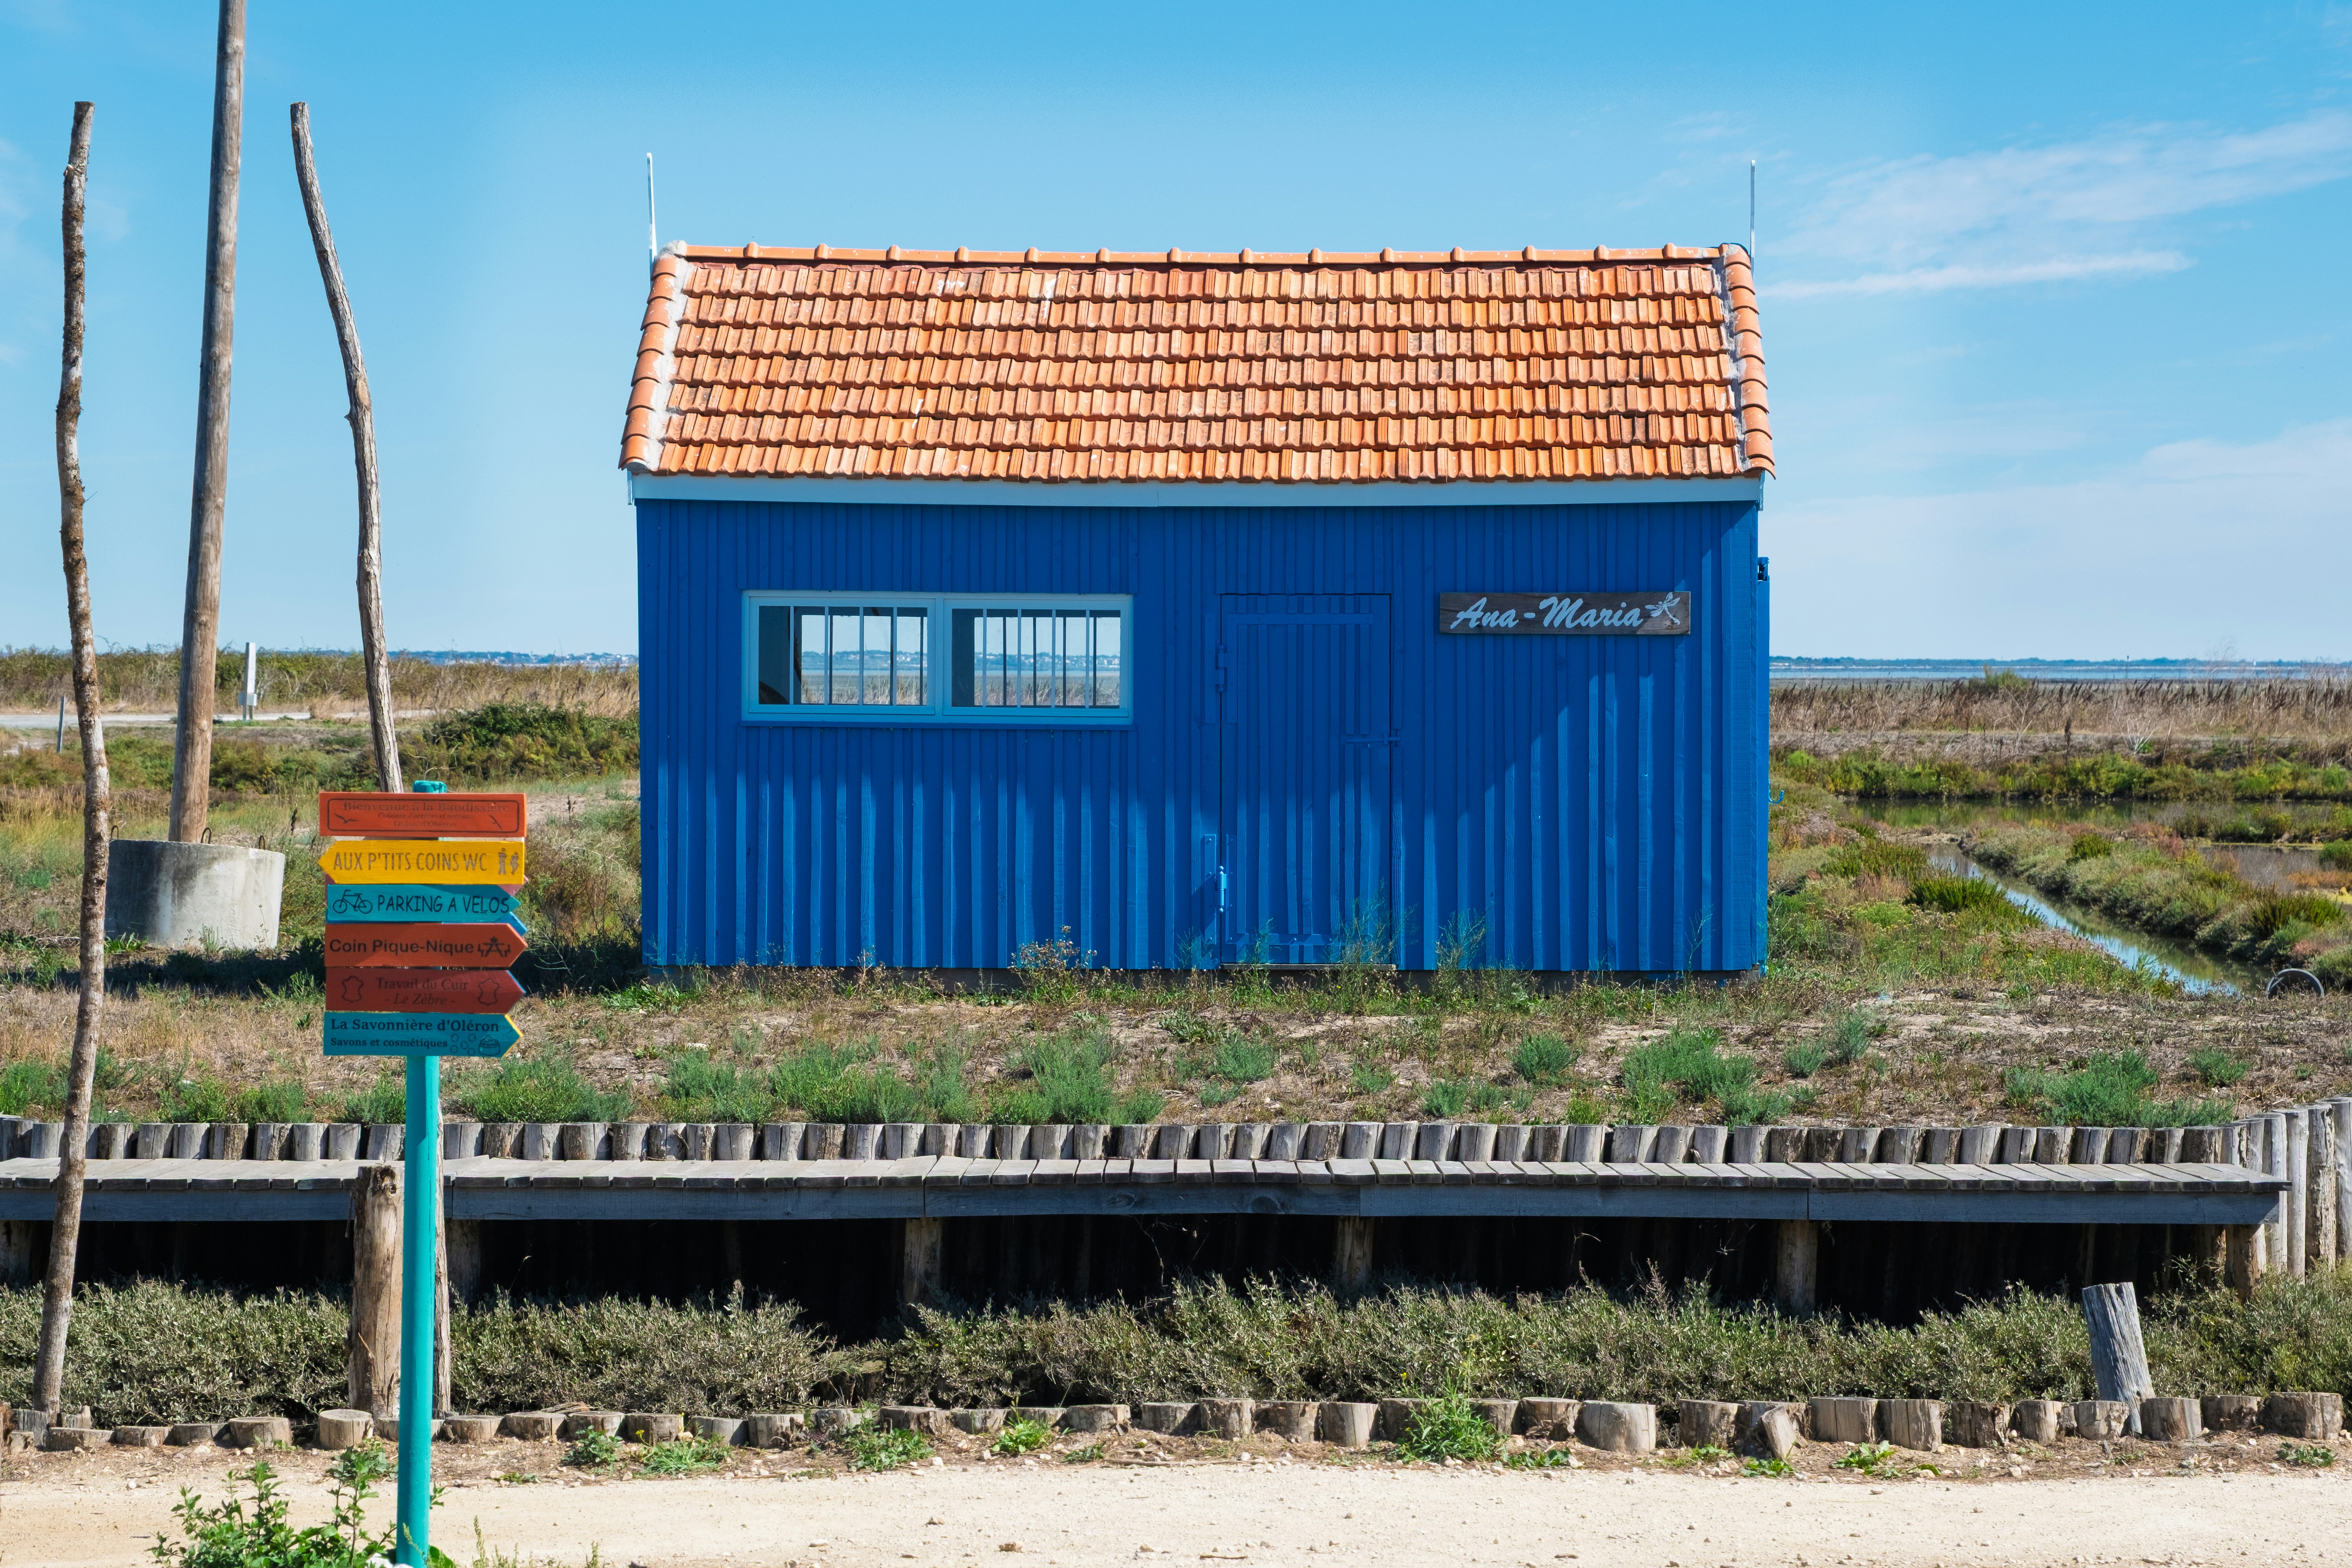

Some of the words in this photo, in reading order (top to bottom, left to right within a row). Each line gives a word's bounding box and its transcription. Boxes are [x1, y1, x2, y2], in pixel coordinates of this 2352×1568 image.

[1450, 596, 1643, 630] Ana-Maria
[343, 801, 408, 811] Bienvenue
[412, 802, 419, 811] à
[423, 802, 433, 811] la
[437, 802, 510, 812] Baudissière
[420, 820, 457, 828] d'Oléron
[333, 852, 363, 871] AUX
[368, 852, 411, 871] P'TITS
[416, 853, 459, 871] COINS
[463, 853, 487, 872] WC
[377, 894, 443, 913] PARKING
[447, 896, 457, 913] A
[463, 895, 510, 915] VELOS
[329, 939, 367, 953] Coin
[372, 940, 474, 956] Pique-Nique
[376, 977, 418, 989] Travail
[422, 978, 437, 990] du
[441, 978, 468, 991] Cuir
[393, 993, 409, 1004] Le
[412, 993, 447, 1005] Zèbre
[330, 1019, 348, 1030] La
[352, 1019, 433, 1031] Savonnière
[437, 1020, 499, 1032] d'Oléron
[330, 1037, 367, 1046] Savons
[370, 1038, 380, 1046] et
[383, 1038, 448, 1049] cosmétiques
